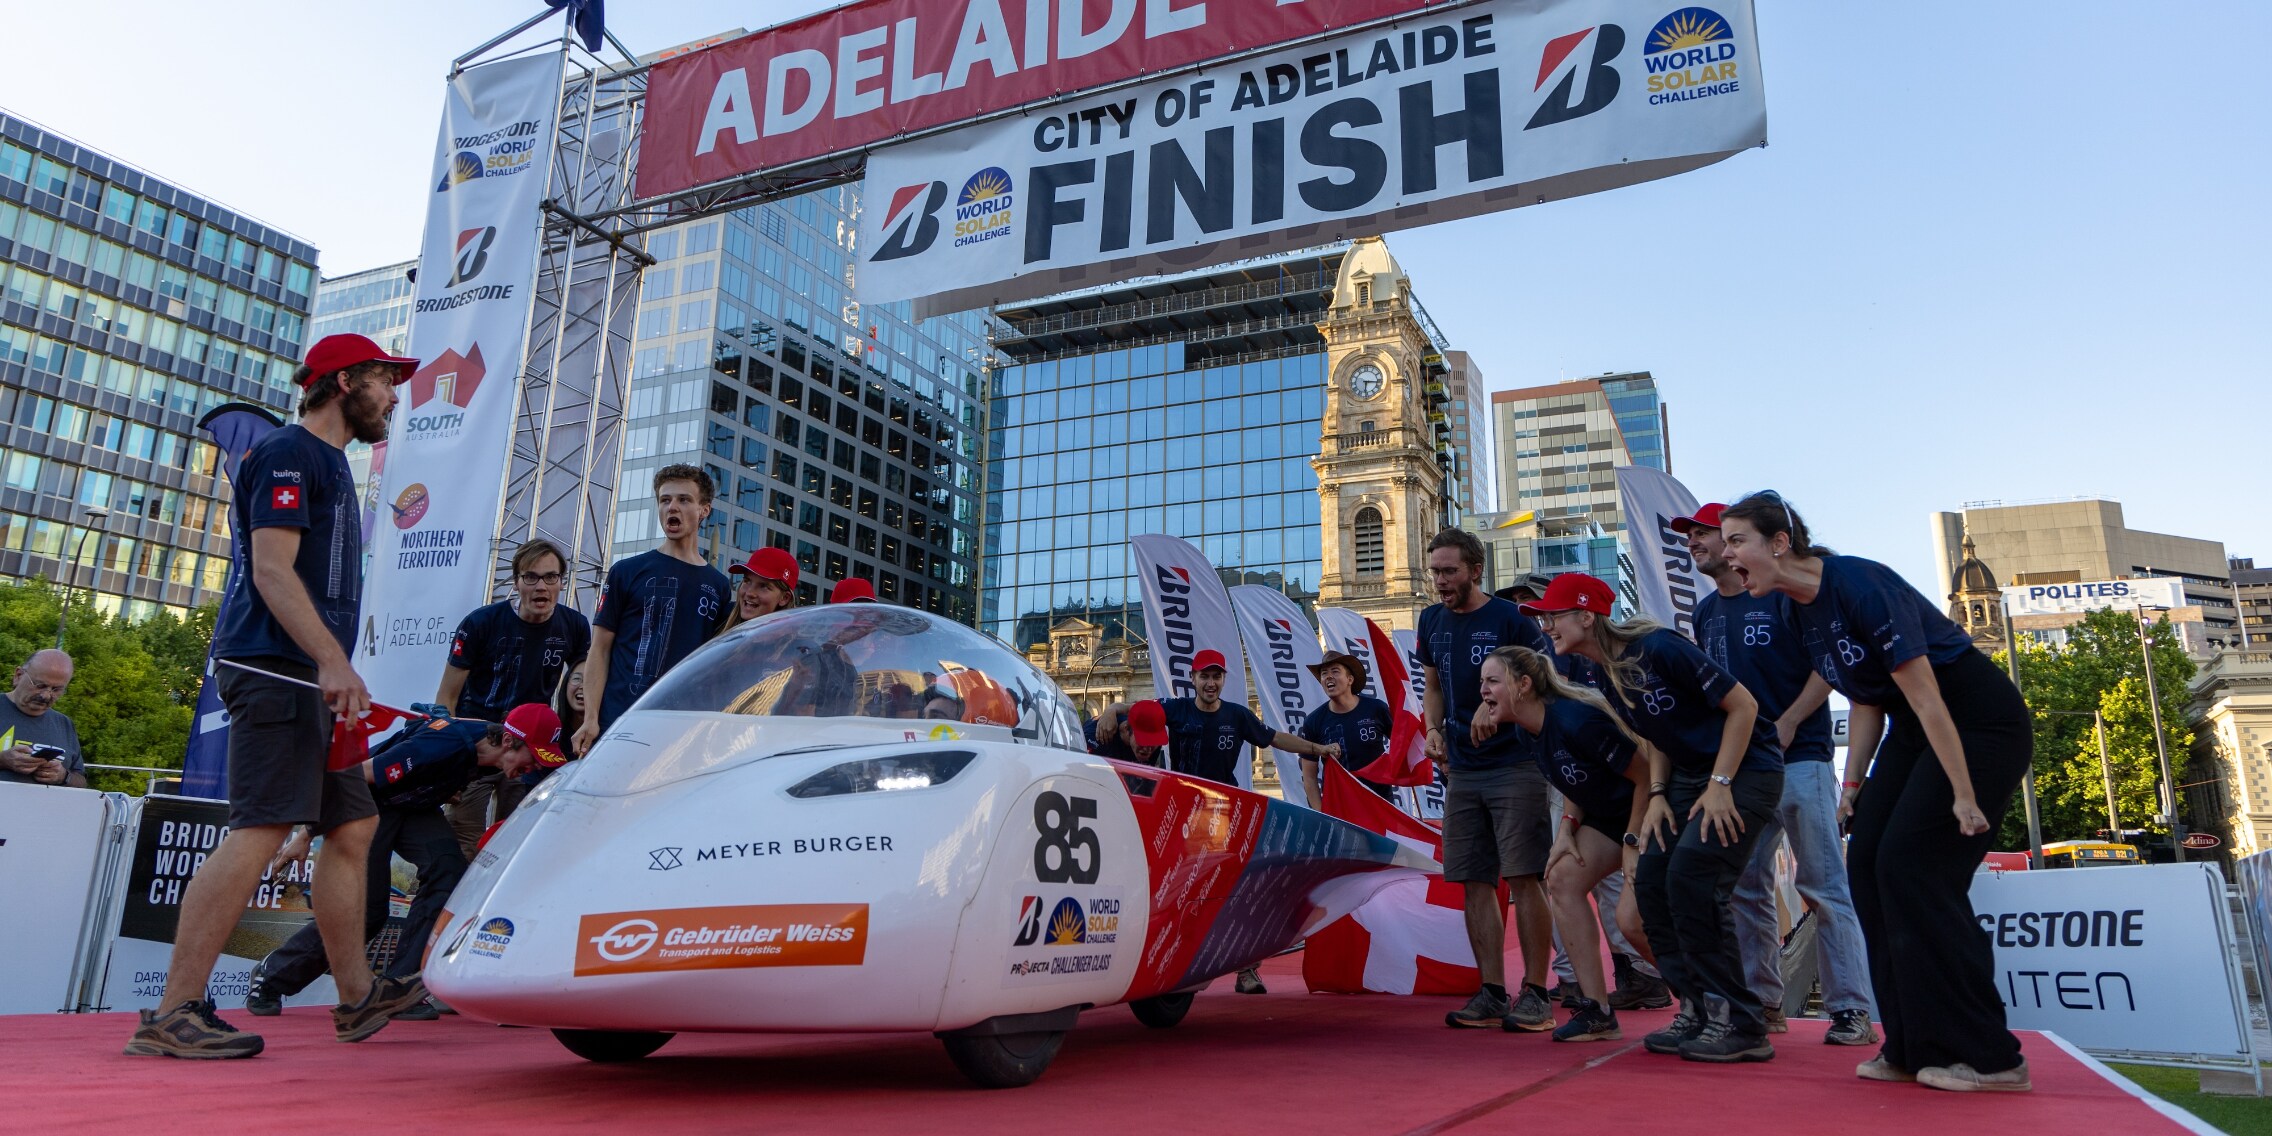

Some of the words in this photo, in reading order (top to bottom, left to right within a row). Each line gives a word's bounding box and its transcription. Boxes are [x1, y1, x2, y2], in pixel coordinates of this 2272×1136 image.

[1644, 43, 1737, 73] WORLD
[1034, 99, 1137, 153] CITY
[1155, 79, 1217, 128] OF
[1231, 14, 1497, 112] ADELAIDE
[1647, 62, 1739, 92] SOLAR
[1649, 81, 1740, 105] CHALLENGE
[489, 138, 536, 156] WORLD
[486, 149, 534, 169] SOLAR
[1024, 68, 1504, 265] FINISH
[486, 161, 531, 178] CHALLENGE
[956, 193, 1013, 222] WORLD
[954, 210, 1011, 238] SOLAR
[954, 227, 1011, 248] CHALLENGE
[416, 284, 514, 313] BRIDGESTONE
[406, 412, 464, 433] SOUTH
[405, 429, 460, 442] AUSTRALIA
[273, 469, 300, 483] twing
[1477, 517, 1495, 531] EY
[401, 530, 464, 549] NORTHERN
[398, 550, 462, 570] TERRITORY
[2030, 582, 2129, 600] POLITES
[698, 596, 719, 620] 85
[393, 618, 422, 632] CITY
[427, 616, 445, 630] OF
[1156, 563, 1198, 699] BRIDGE
[390, 631, 456, 647] ADELAIDE
[1743, 625, 1771, 646] 85
[542, 649, 563, 667] 85
[1643, 687, 1675, 716] 85
[1218, 735, 1235, 750] 85
[1360, 727, 1377, 741] 85
[1561, 763, 1588, 786] 85
[1153, 795, 1177, 854] TRIBECRAFT
[1034, 790, 1101, 885] 85
[2186, 836, 2214, 845] Adina
[697, 841, 782, 861] MEYER
[794, 836, 893, 853] BURGER
[155, 850, 207, 877] WOR
[1177, 864, 1199, 911] ESORO
[1090, 898, 1120, 914] WORLD
[1088, 916, 1119, 932] SOLAR
[1976, 909, 2144, 948] GESTONE
[476, 932, 510, 945] WORLD
[664, 924, 781, 946] Gebrüder
[786, 923, 855, 943] Weiss
[1086, 933, 1116, 944] CHALLENGE
[468, 948, 502, 960] CHALLENGE
[471, 940, 506, 953] SOLAR
[658, 947, 710, 958] Transport
[712, 946, 732, 956] and
[734, 945, 782, 956] Logistics
[1051, 955, 1091, 975] CHALLENGER
[1091, 954, 1112, 972] CLASS
[135, 972, 168, 984] DARW
[211, 985, 249, 996] OCTOB
[2003, 970, 2136, 1012] ITEN
